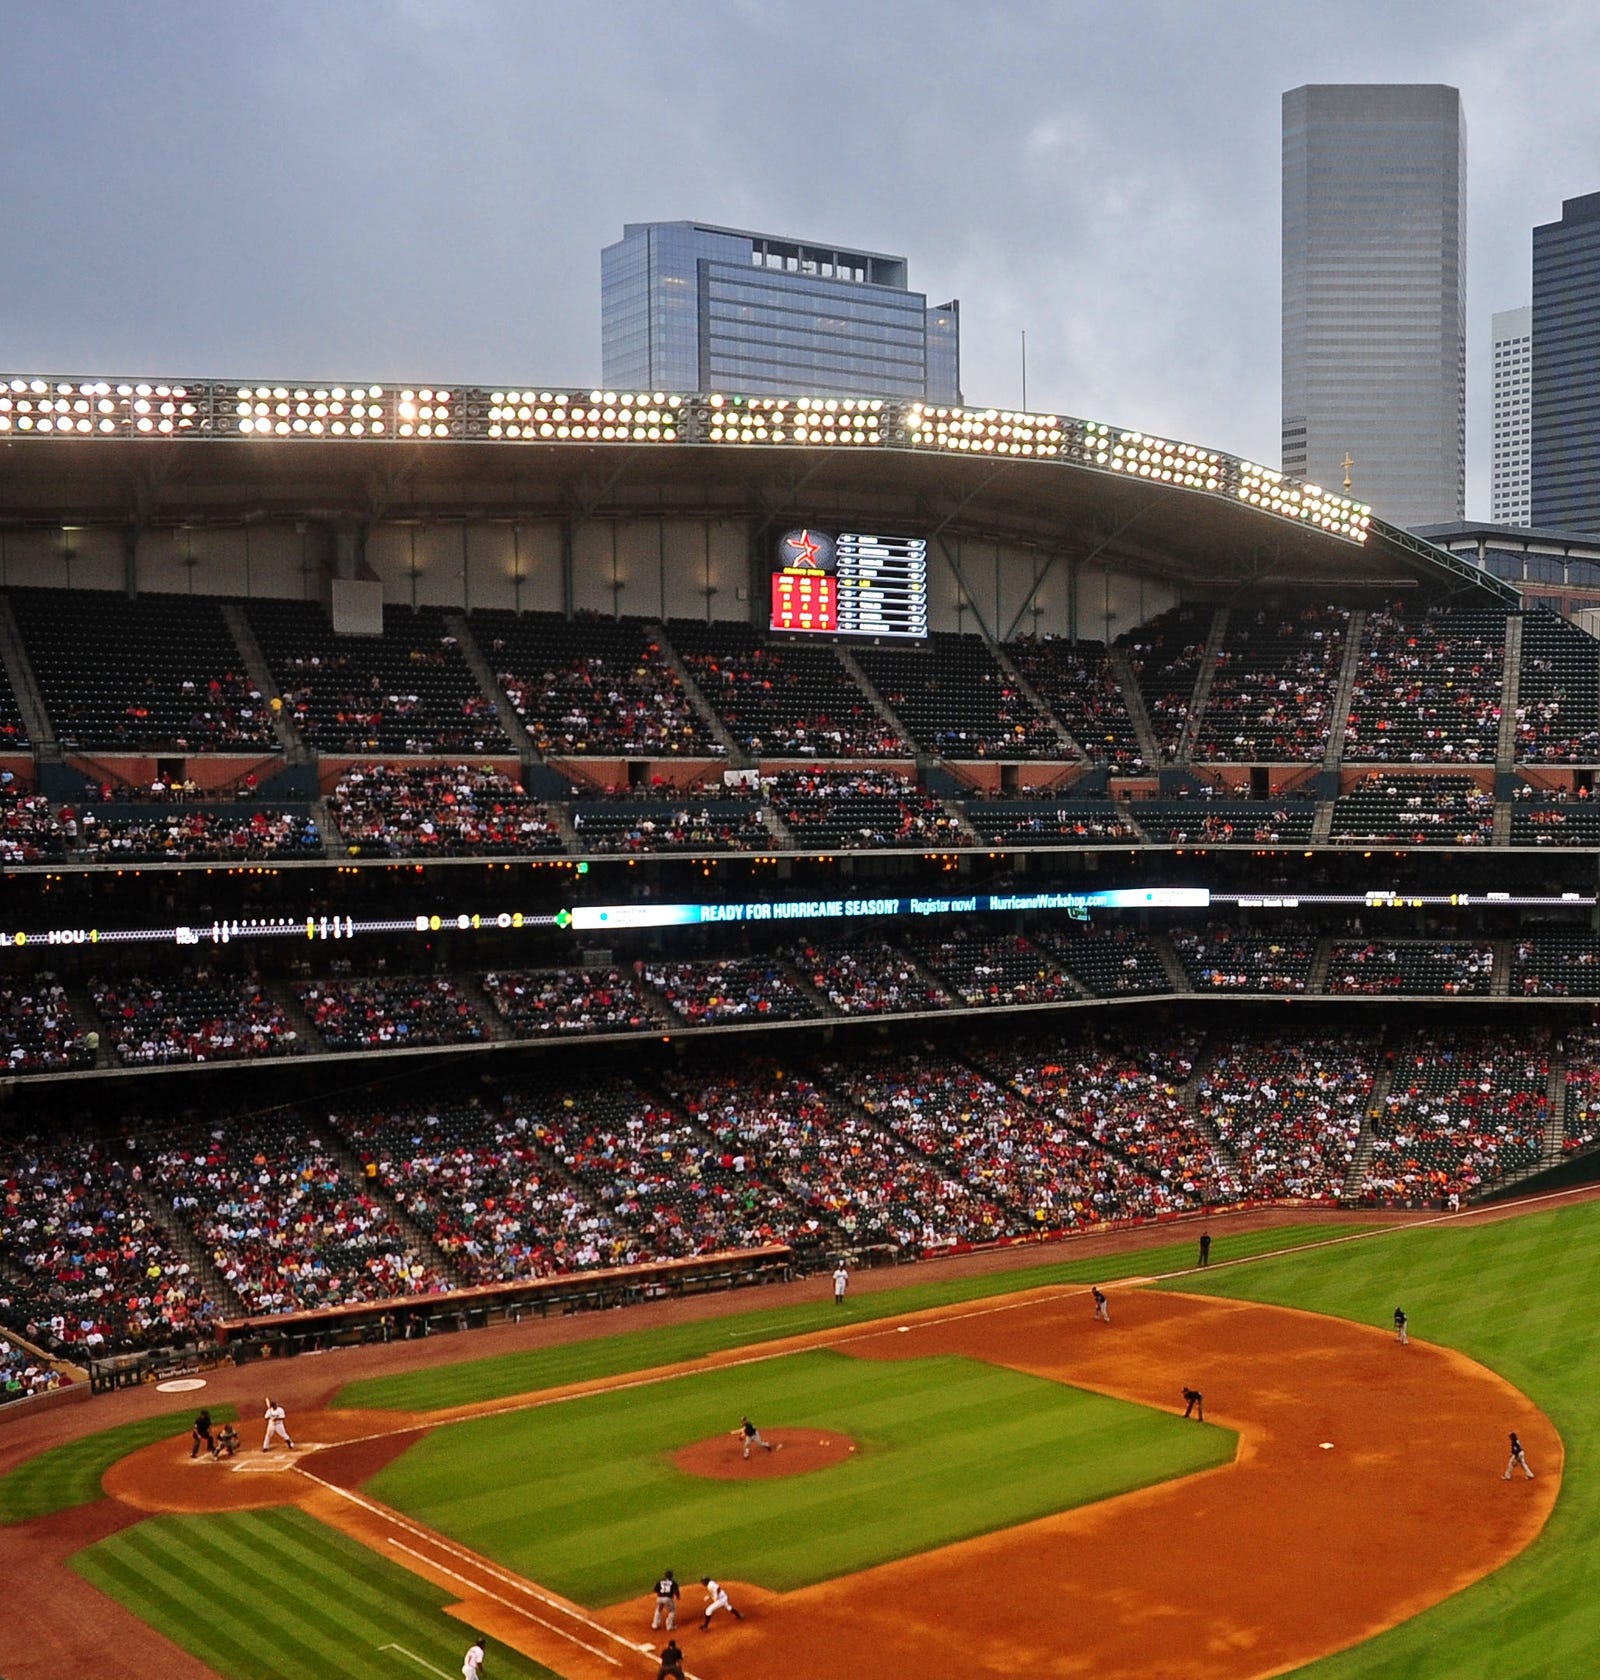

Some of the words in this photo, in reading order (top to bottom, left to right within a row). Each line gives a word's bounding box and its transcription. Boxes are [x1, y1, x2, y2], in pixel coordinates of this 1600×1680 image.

[910, 897, 950, 916] Register
[951, 896, 976, 912] now!
[989, 893, 1108, 911] HurricaneWorkshop.com
[701, 905, 744, 922] READY
[746, 903, 771, 920] FOR
[773, 901, 843, 919] HURRICANE
[845, 899, 900, 916] SEASON?
[416, 915, 429, 931] B
[429, 915, 441, 931] 0
[471, 913, 480, 929] 1
[512, 912, 524, 928] 2
[15, 931, 26, 946] 0
[48, 930, 85, 944] HOU
[89, 929, 97, 943] 1
